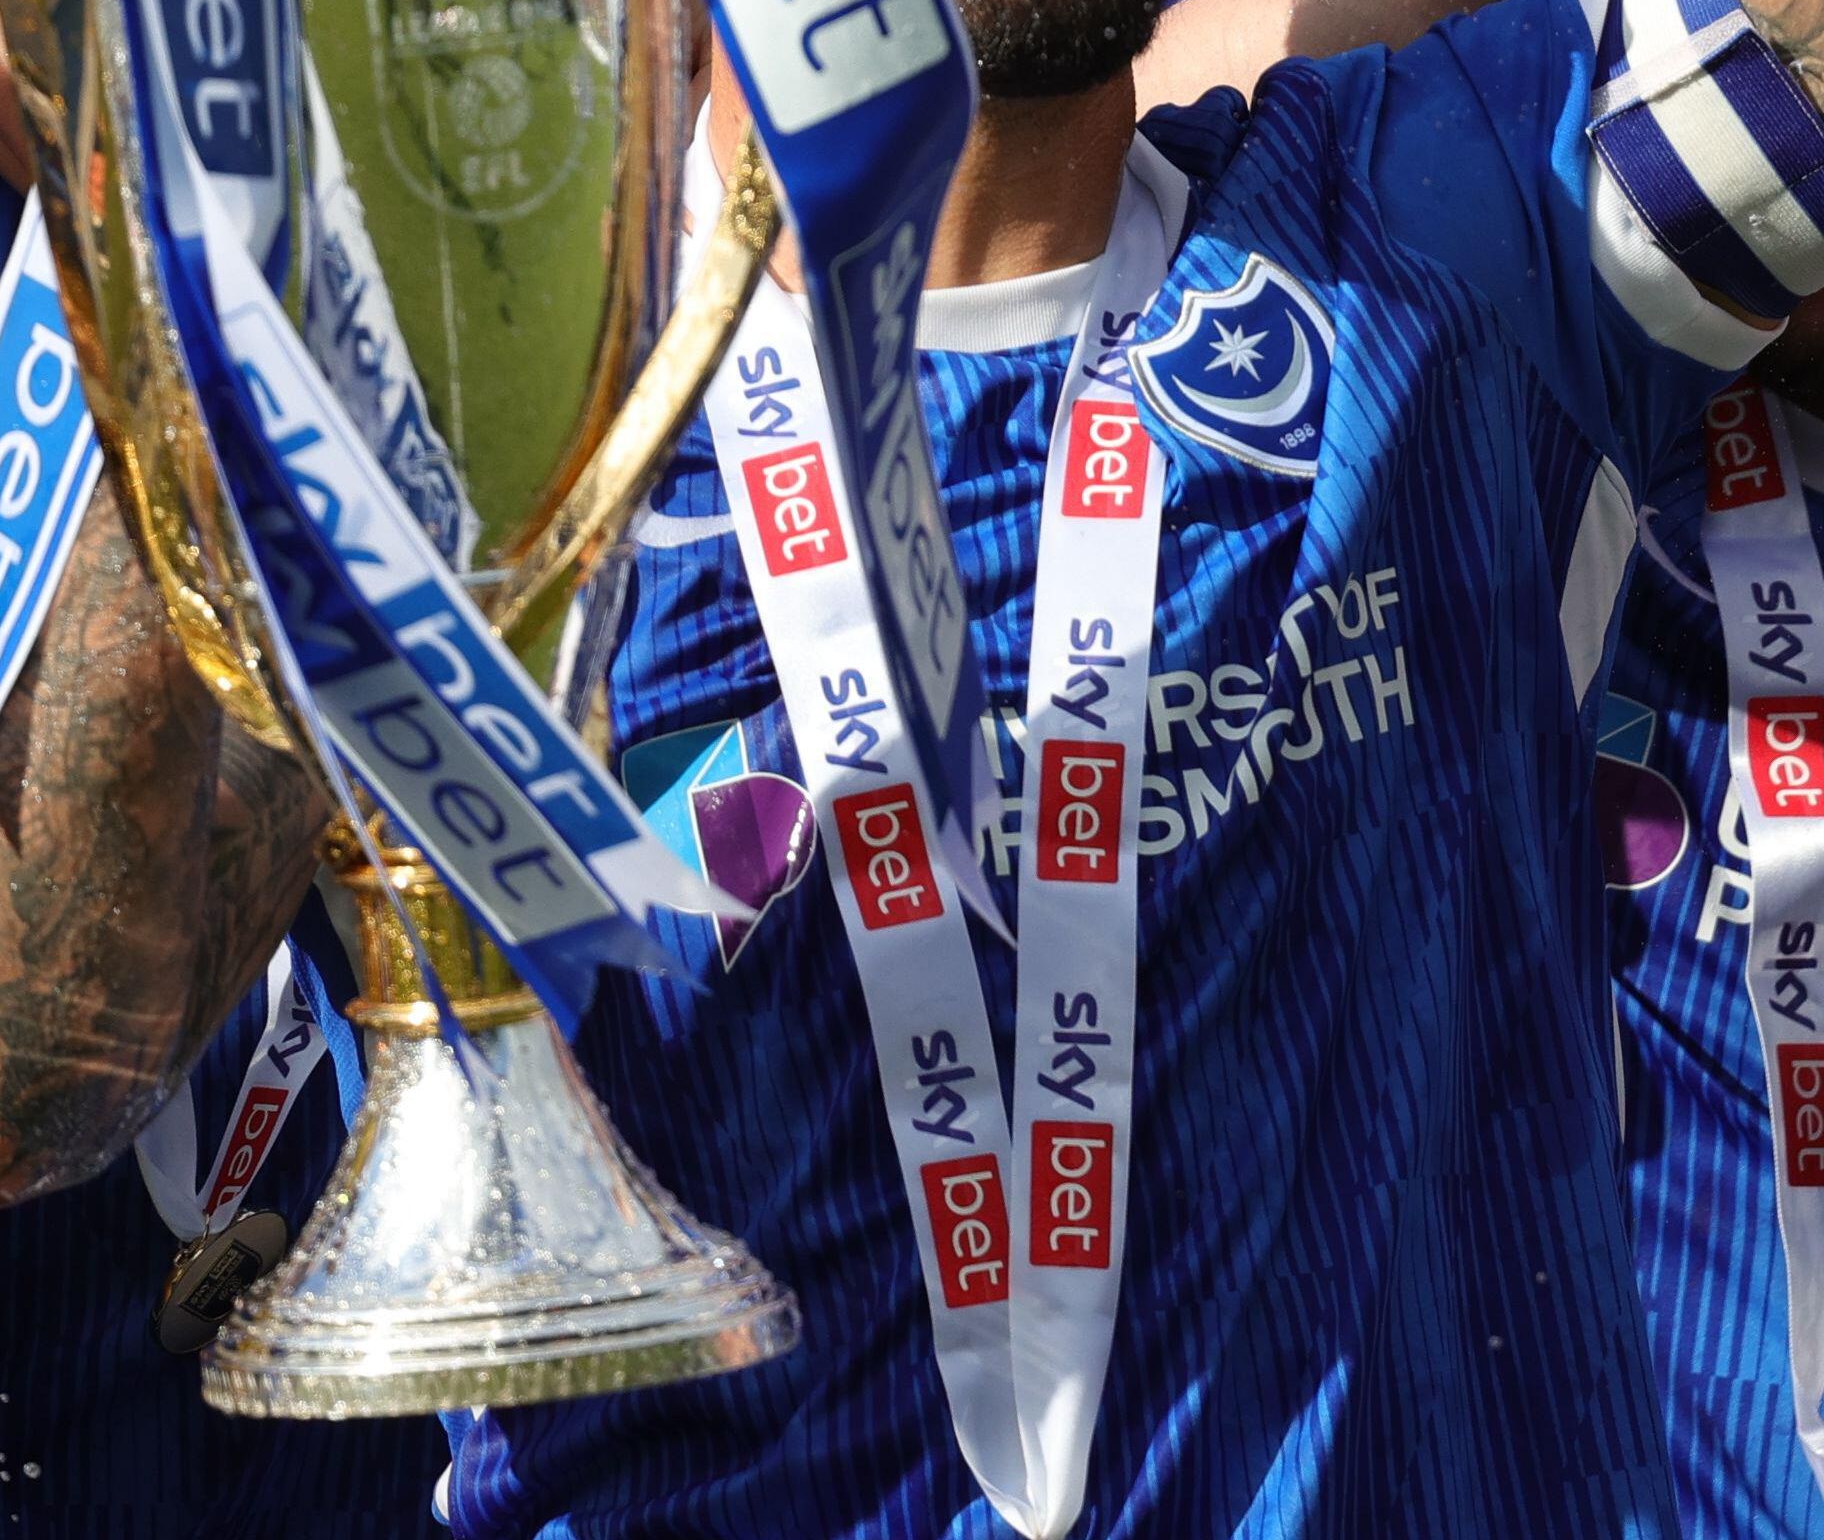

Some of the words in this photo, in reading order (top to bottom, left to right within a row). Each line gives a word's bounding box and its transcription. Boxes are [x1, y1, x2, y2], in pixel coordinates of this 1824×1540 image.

[738, 346, 801, 440] sky
[1278, 423, 1317, 451] 1898
[1703, 389, 1768, 498] bet
[766, 453, 829, 561] bet
[1088, 412, 1142, 508] bet
[883, 412, 955, 677] bet
[1336, 567, 1401, 640] OF
[1749, 579, 1813, 684] sky
[393, 611, 603, 819] bet
[1050, 617, 1127, 731] sky
[353, 696, 565, 904] bet
[820, 667, 886, 776] sky
[855, 799, 926, 914] bet
[1055, 755, 1117, 870] bet
[1764, 710, 1824, 810] bet
[1769, 919, 1818, 1033] sky
[910, 1027, 976, 1145] sky
[1037, 990, 1113, 1112] sky
[941, 1169, 1007, 1294] bet
[1048, 1134, 1095, 1252] bet
